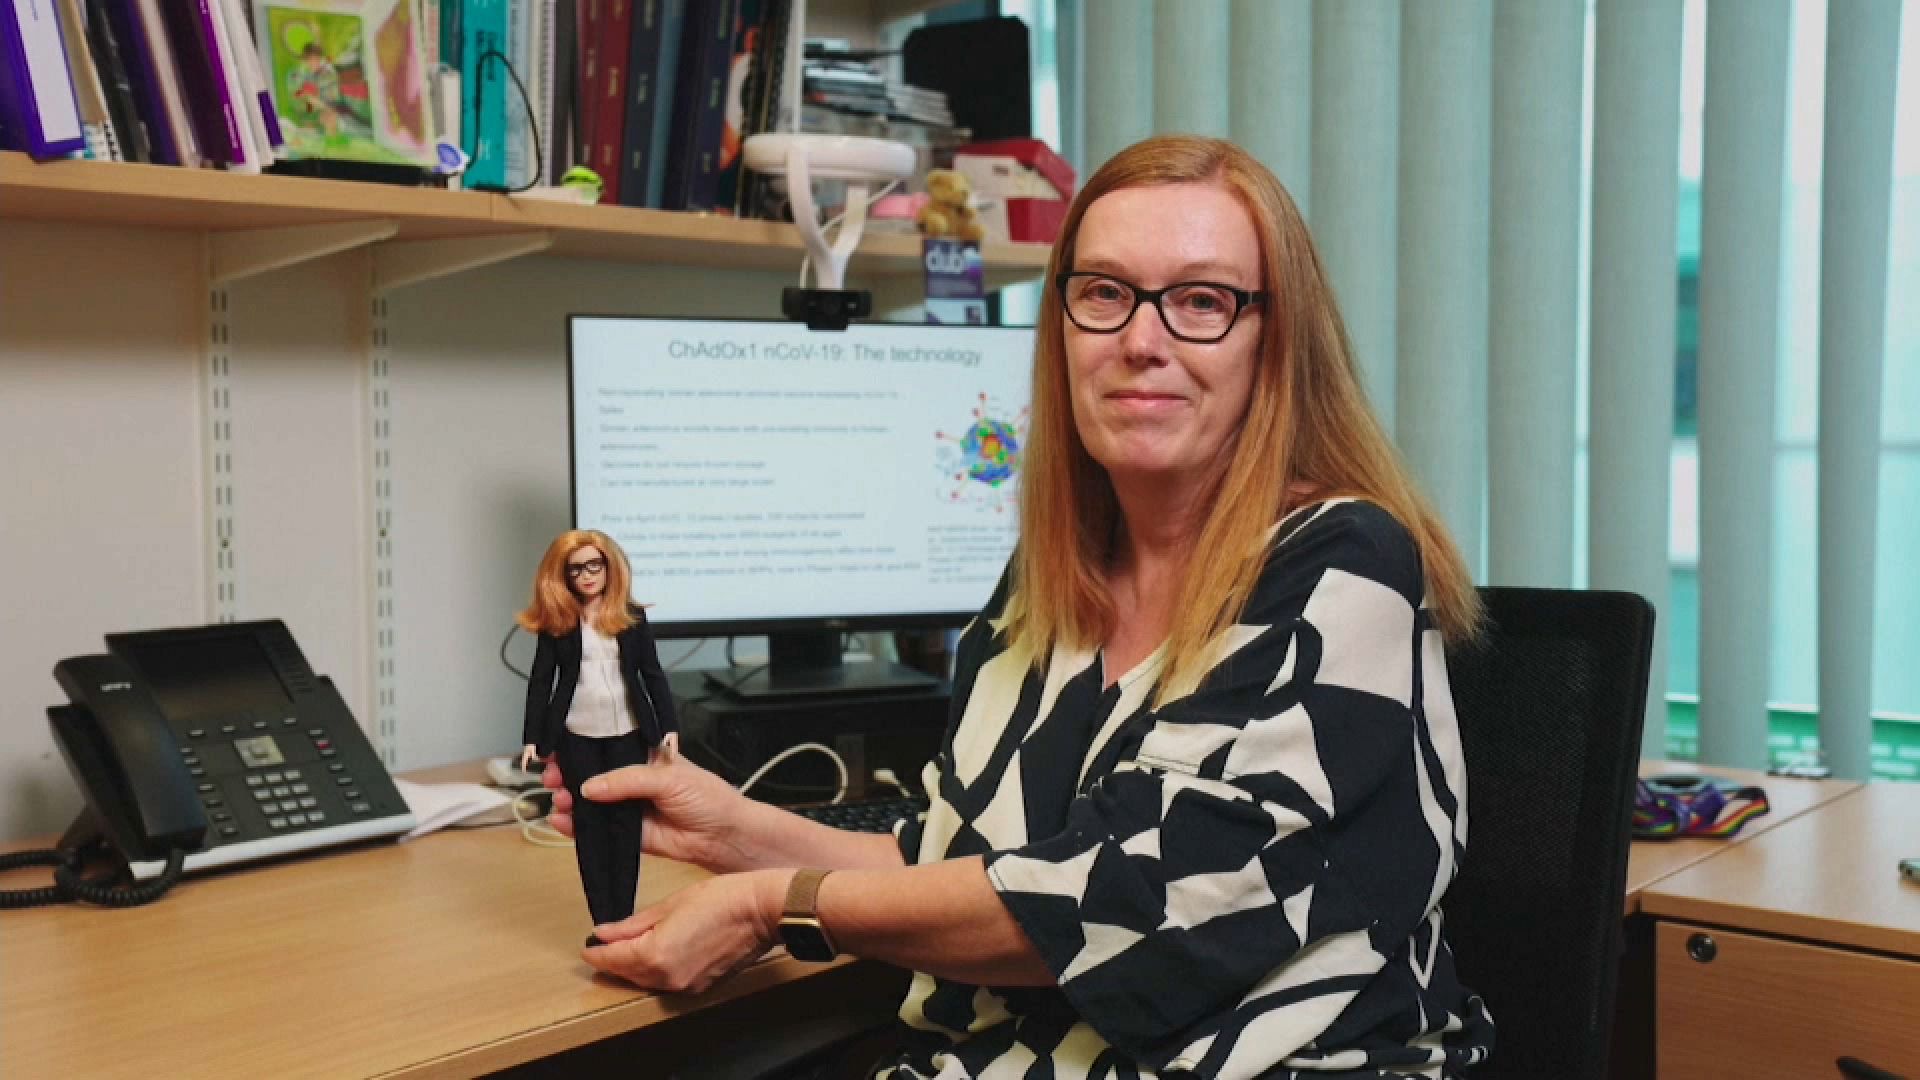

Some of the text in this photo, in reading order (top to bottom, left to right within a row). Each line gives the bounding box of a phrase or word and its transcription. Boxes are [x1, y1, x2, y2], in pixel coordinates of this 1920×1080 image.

[668, 340, 983, 367] ChAdOx1 nCoV-19: The technology
